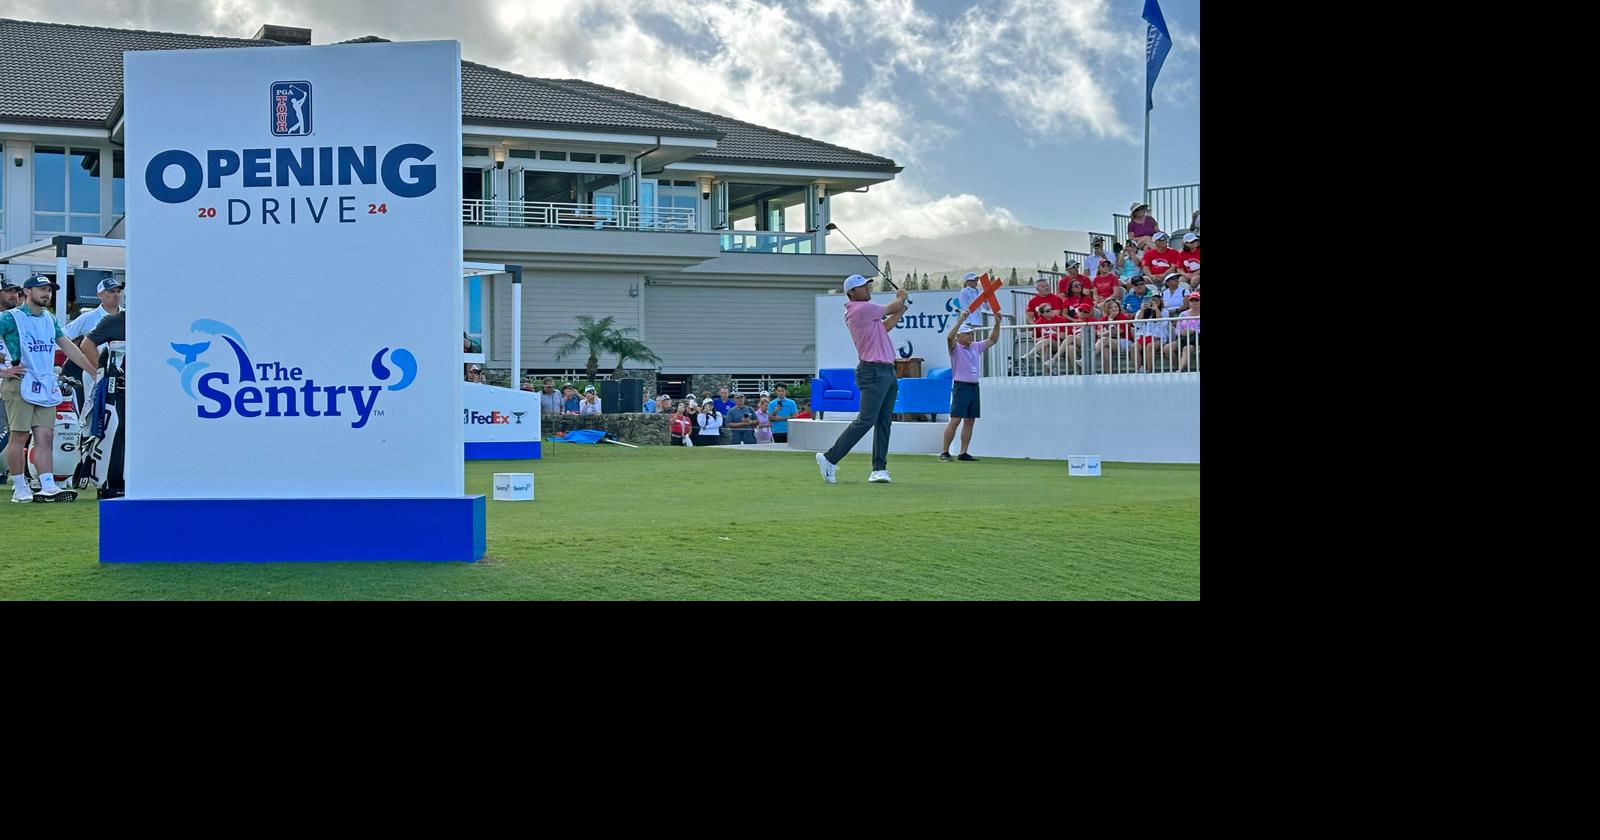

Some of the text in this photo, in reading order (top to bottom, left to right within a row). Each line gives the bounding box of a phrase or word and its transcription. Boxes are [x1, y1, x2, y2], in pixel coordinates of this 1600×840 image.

[276, 95, 288, 132] TOUR
[145, 143, 437, 204] OPENING
[198, 196, 388, 226] 20 DRIVE 24
[893, 312, 950, 334] entry
[256, 362, 303, 381] The
[197, 372, 382, 429] Sentry
[471, 410, 510, 425] FedEx
